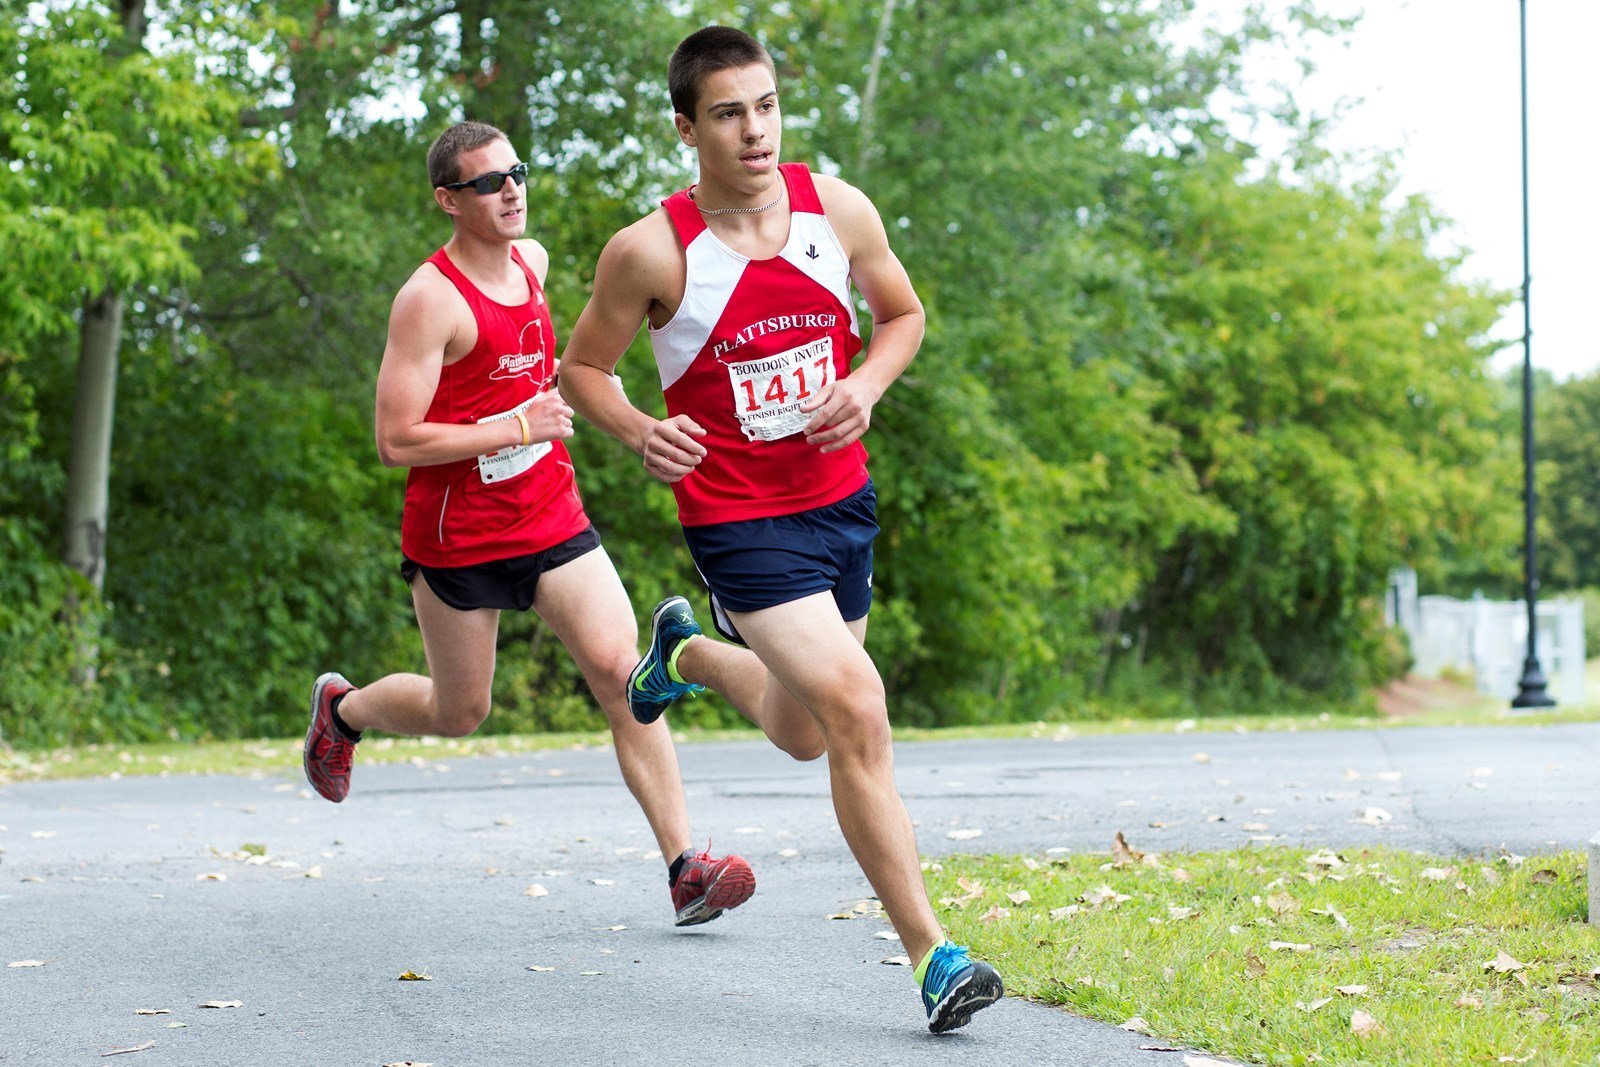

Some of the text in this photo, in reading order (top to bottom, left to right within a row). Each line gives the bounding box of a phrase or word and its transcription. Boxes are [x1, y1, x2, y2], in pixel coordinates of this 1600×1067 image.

[713, 313, 837, 359] PLATTSBURGH
[735, 341, 827, 376] BOWDOIN INVITE
[739, 355, 830, 413] 1417
[747, 402, 801, 422] FINISH RIGHT
[486, 454, 510, 465] FINISH
